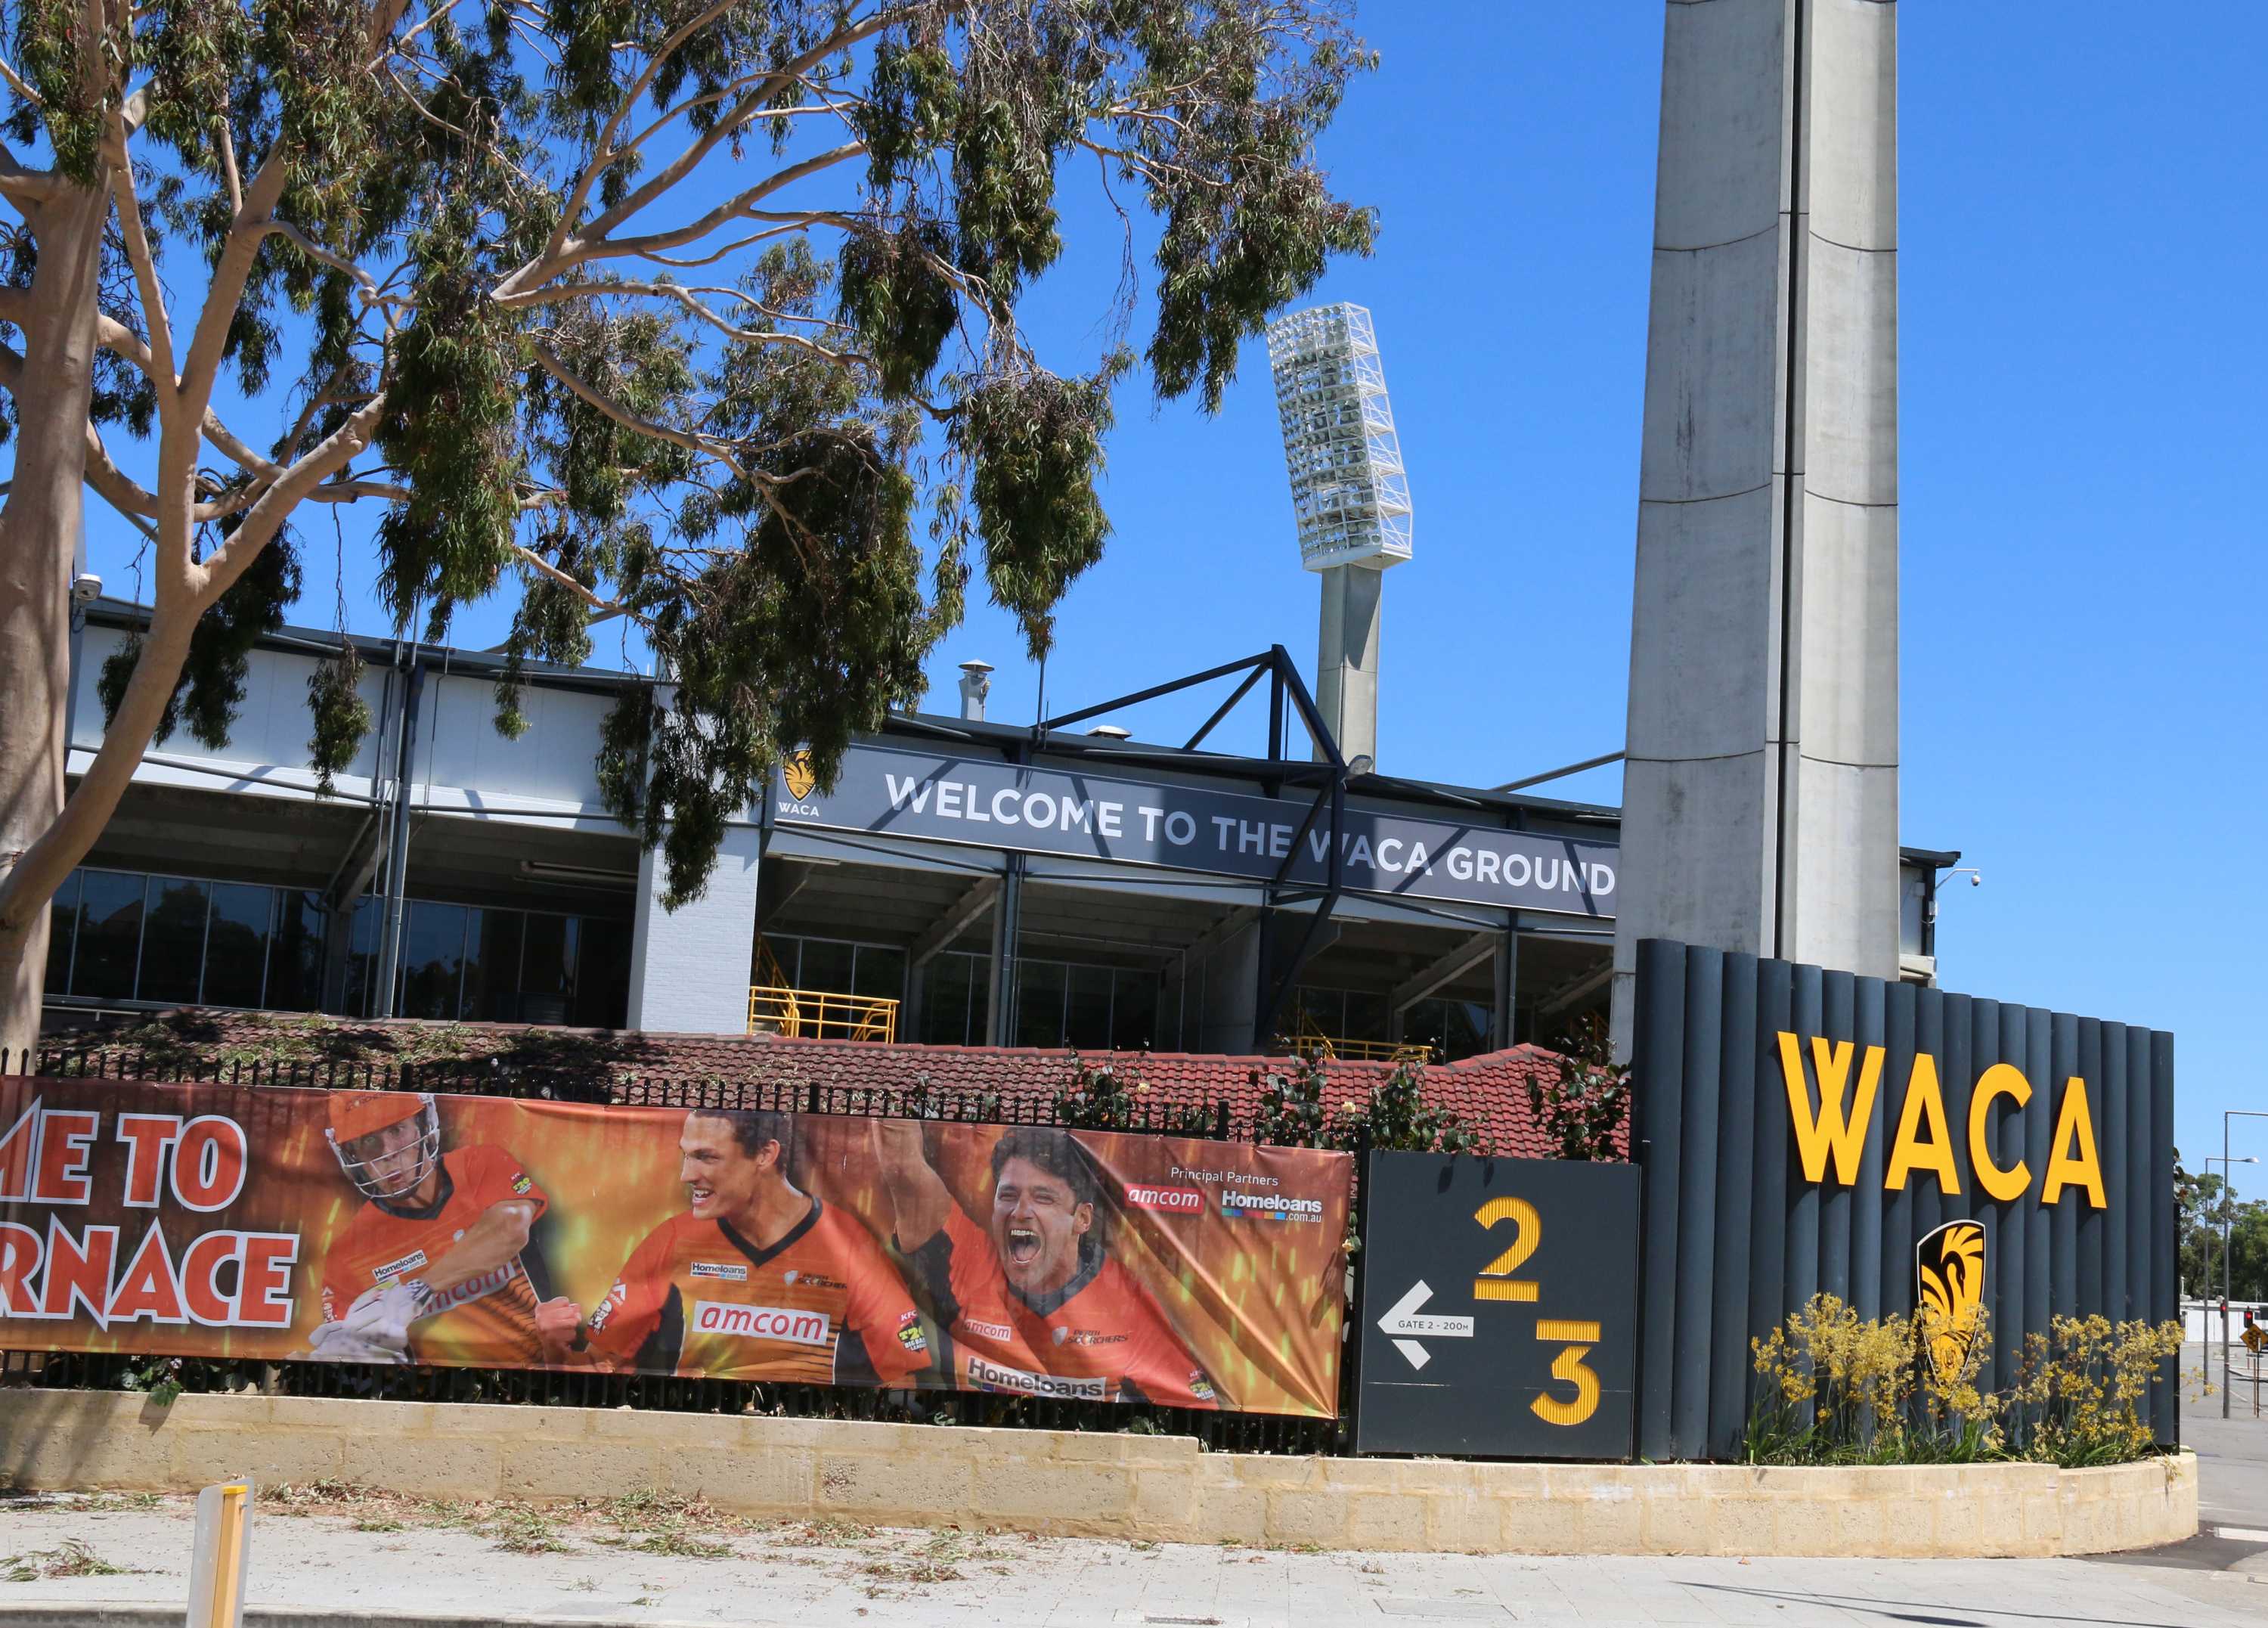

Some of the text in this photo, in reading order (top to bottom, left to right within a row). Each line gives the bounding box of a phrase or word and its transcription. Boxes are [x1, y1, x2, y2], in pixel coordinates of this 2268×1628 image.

[779, 802, 820, 817] WACA
[885, 774, 1615, 896] WELCOME TO THE WACA GROUND
[1777, 1031, 2107, 1208] WACA
[116, 1113, 247, 1212] TO
[1171, 1168, 1279, 1186] Principal Partners
[1128, 1189, 1199, 1207] amcom
[1222, 1190, 1322, 1213] Homeloans
[1286, 1213, 1321, 1223] .com.au
[1473, 1196, 1542, 1302] 2
[374, 1251, 424, 1277] Homeloans
[692, 1263, 745, 1274] Homeloans
[413, 1262, 510, 1320] mcom
[701, 1306, 824, 1340] amcom
[900, 1310, 917, 1321] KFC
[1398, 1320, 1424, 1329] GATE
[1443, 1322, 1468, 1330] 200M
[964, 1320, 1009, 1338] amcom
[1067, 1334, 1129, 1345] SCORCHERS
[968, 1357, 1103, 1396] Homeloans
[1529, 1319, 1602, 1426] 3
